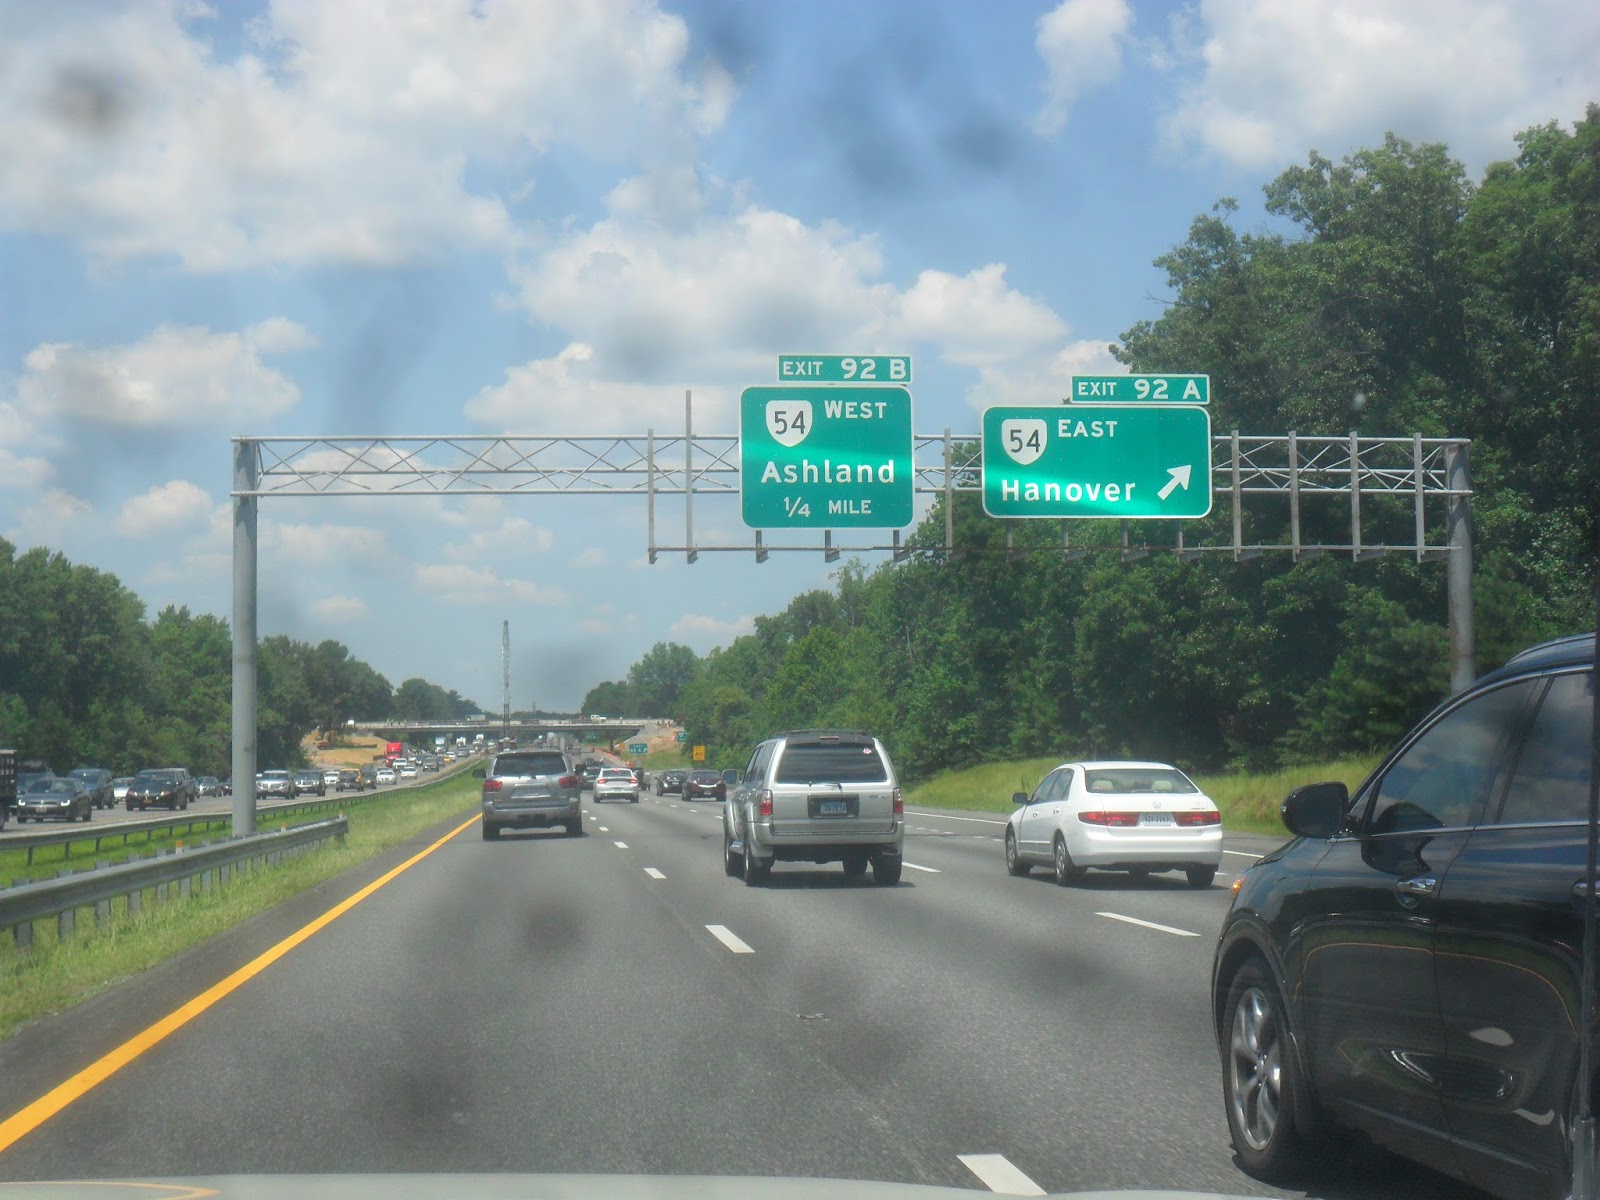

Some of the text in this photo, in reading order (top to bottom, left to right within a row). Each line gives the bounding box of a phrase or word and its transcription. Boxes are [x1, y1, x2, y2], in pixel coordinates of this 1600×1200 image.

[783, 358, 907, 380] EXIT 92 B
[1078, 379, 1201, 400] EXIT 92 A
[774, 400, 887, 435] 54 WEST
[1009, 419, 1117, 454] 54 EAST
[761, 459, 895, 484] Ashland
[1002, 479, 1136, 502] Hanover
[828, 500, 872, 514] MILE
